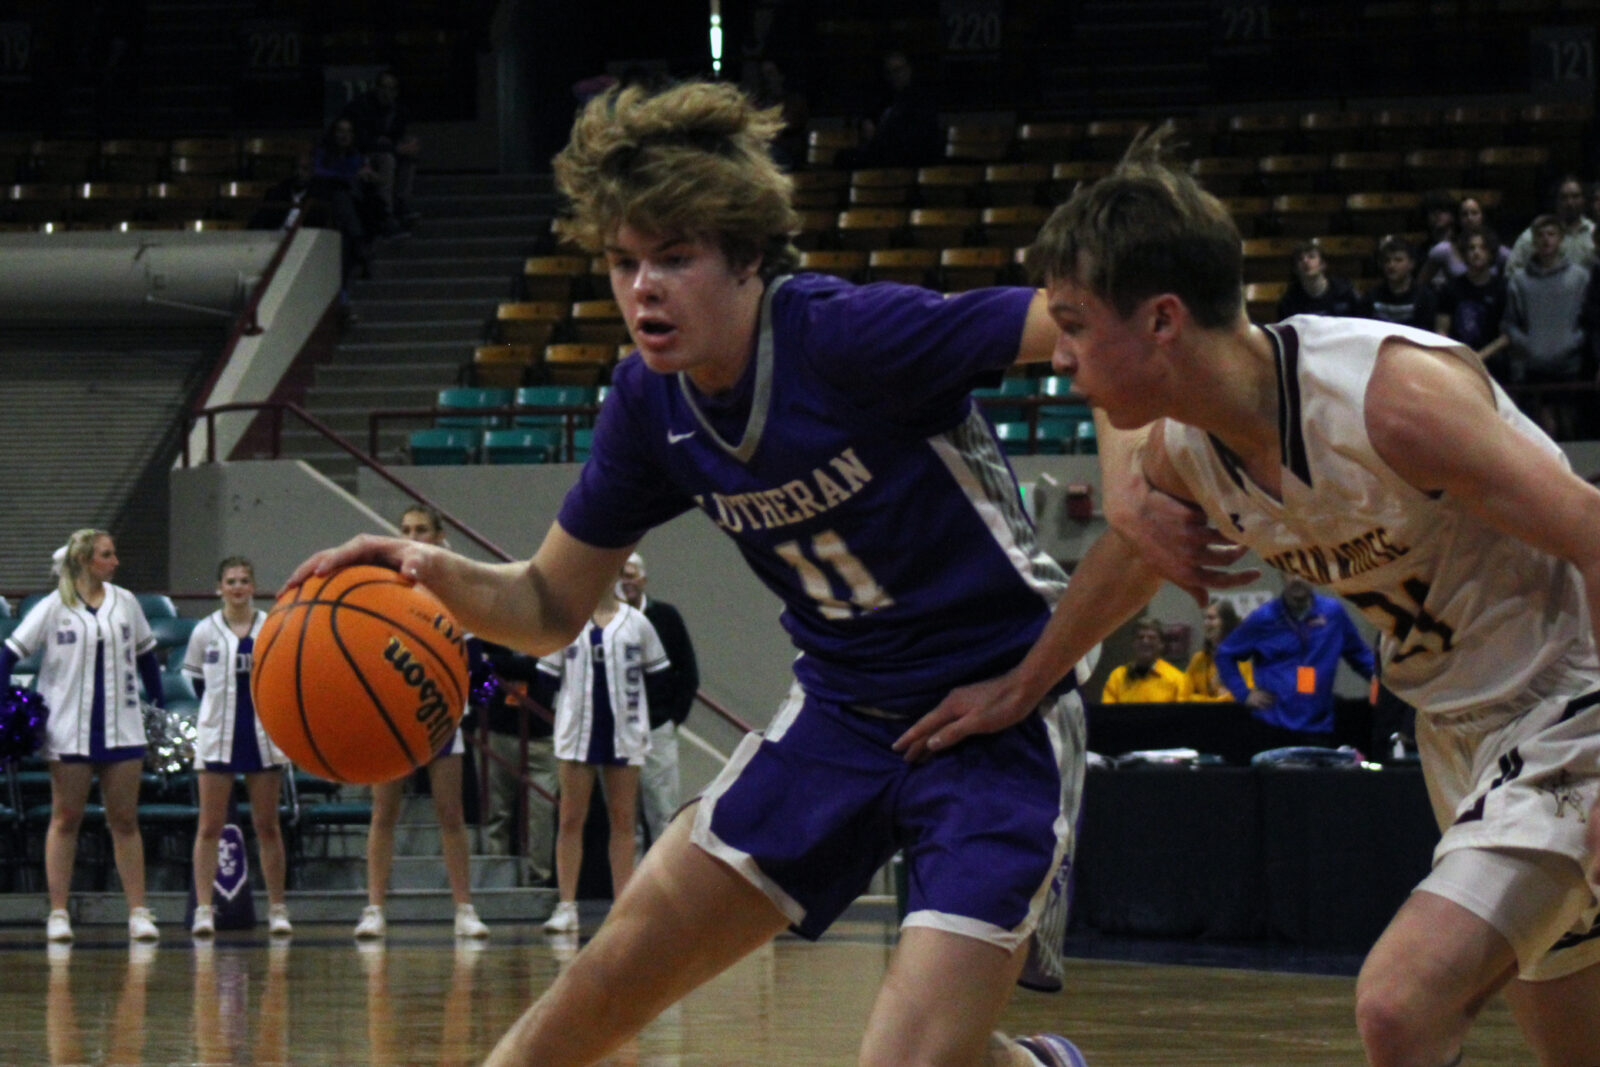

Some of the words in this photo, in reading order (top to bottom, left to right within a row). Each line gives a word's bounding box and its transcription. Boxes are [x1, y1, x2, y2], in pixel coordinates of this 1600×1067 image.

[1548, 40, 1593, 81] 121
[694, 447, 873, 533] UTHERAN
[773, 529, 894, 620] 11
